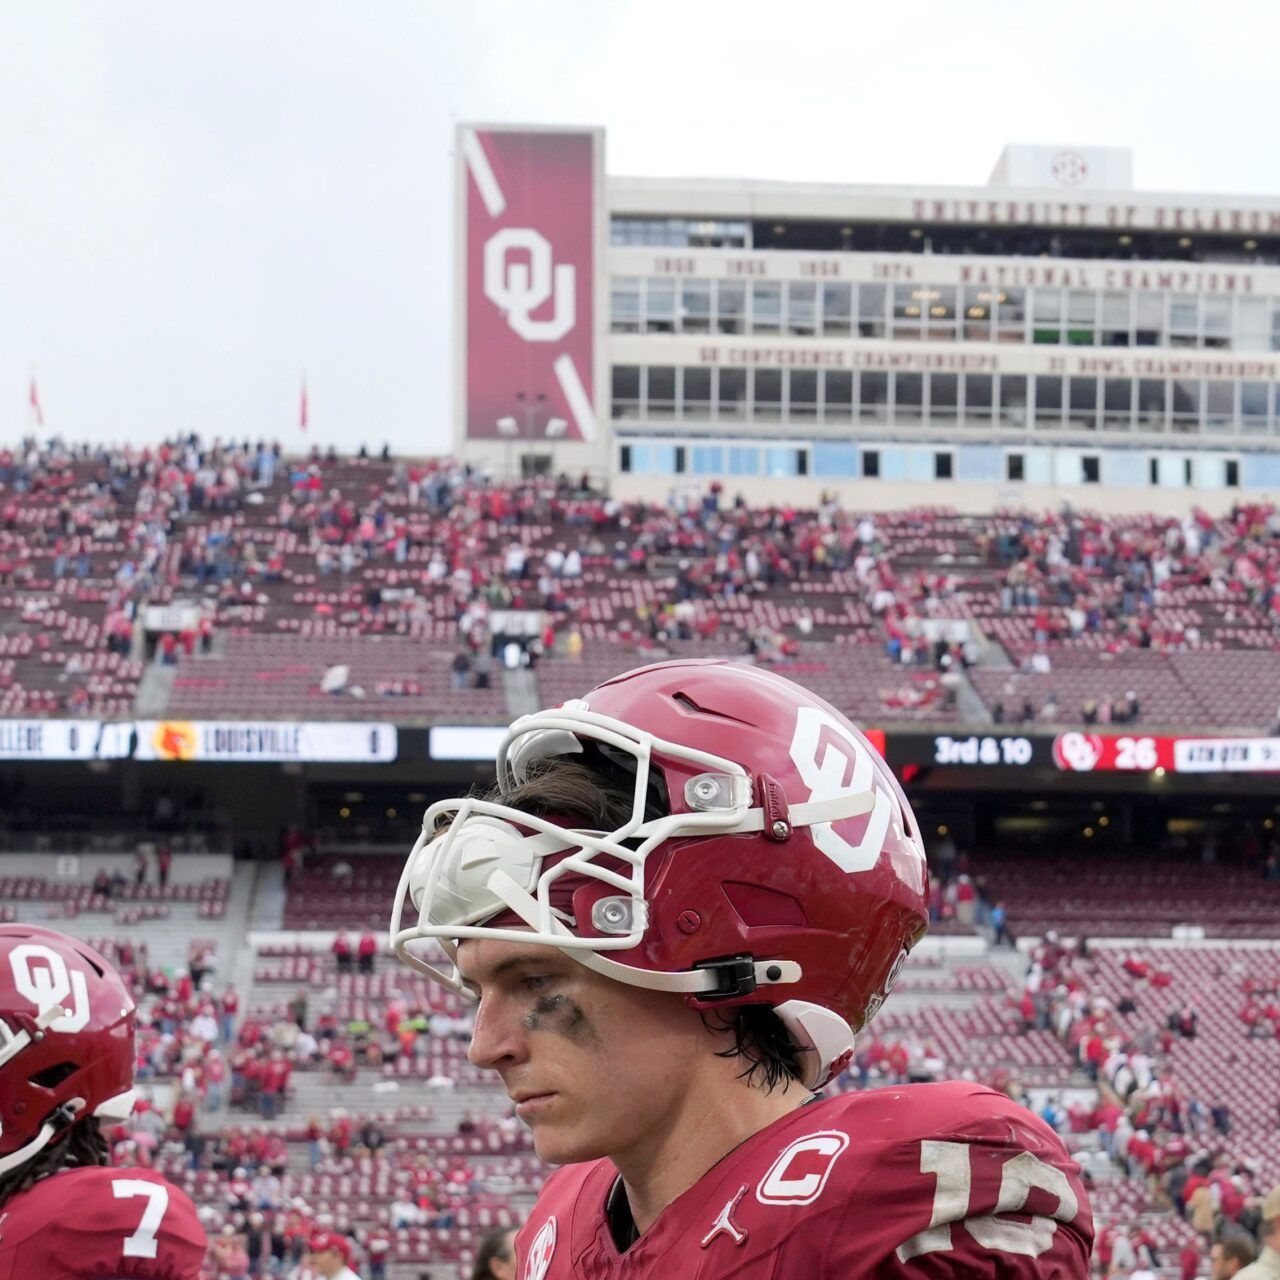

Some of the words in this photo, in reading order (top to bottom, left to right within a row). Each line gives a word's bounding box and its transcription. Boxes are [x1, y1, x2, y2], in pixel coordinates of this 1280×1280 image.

[911, 200, 1091, 226] UNIVERSITY
[1105, 206, 1136, 228] OF
[484, 228, 576, 341] OU
[959, 265, 1092, 289] NATIONAL
[1102, 269, 1255, 294] CHAMPIONS
[204, 728, 300, 754] LOUISVILLE
[934, 736, 978, 765] 3rd
[979, 737, 1000, 765] &
[1001, 737, 1033, 766] 10
[1115, 737, 1158, 770] 26
[8, 943, 91, 1033] OU
[112, 1179, 170, 1258] 7
[896, 1140, 1079, 1264] 10
